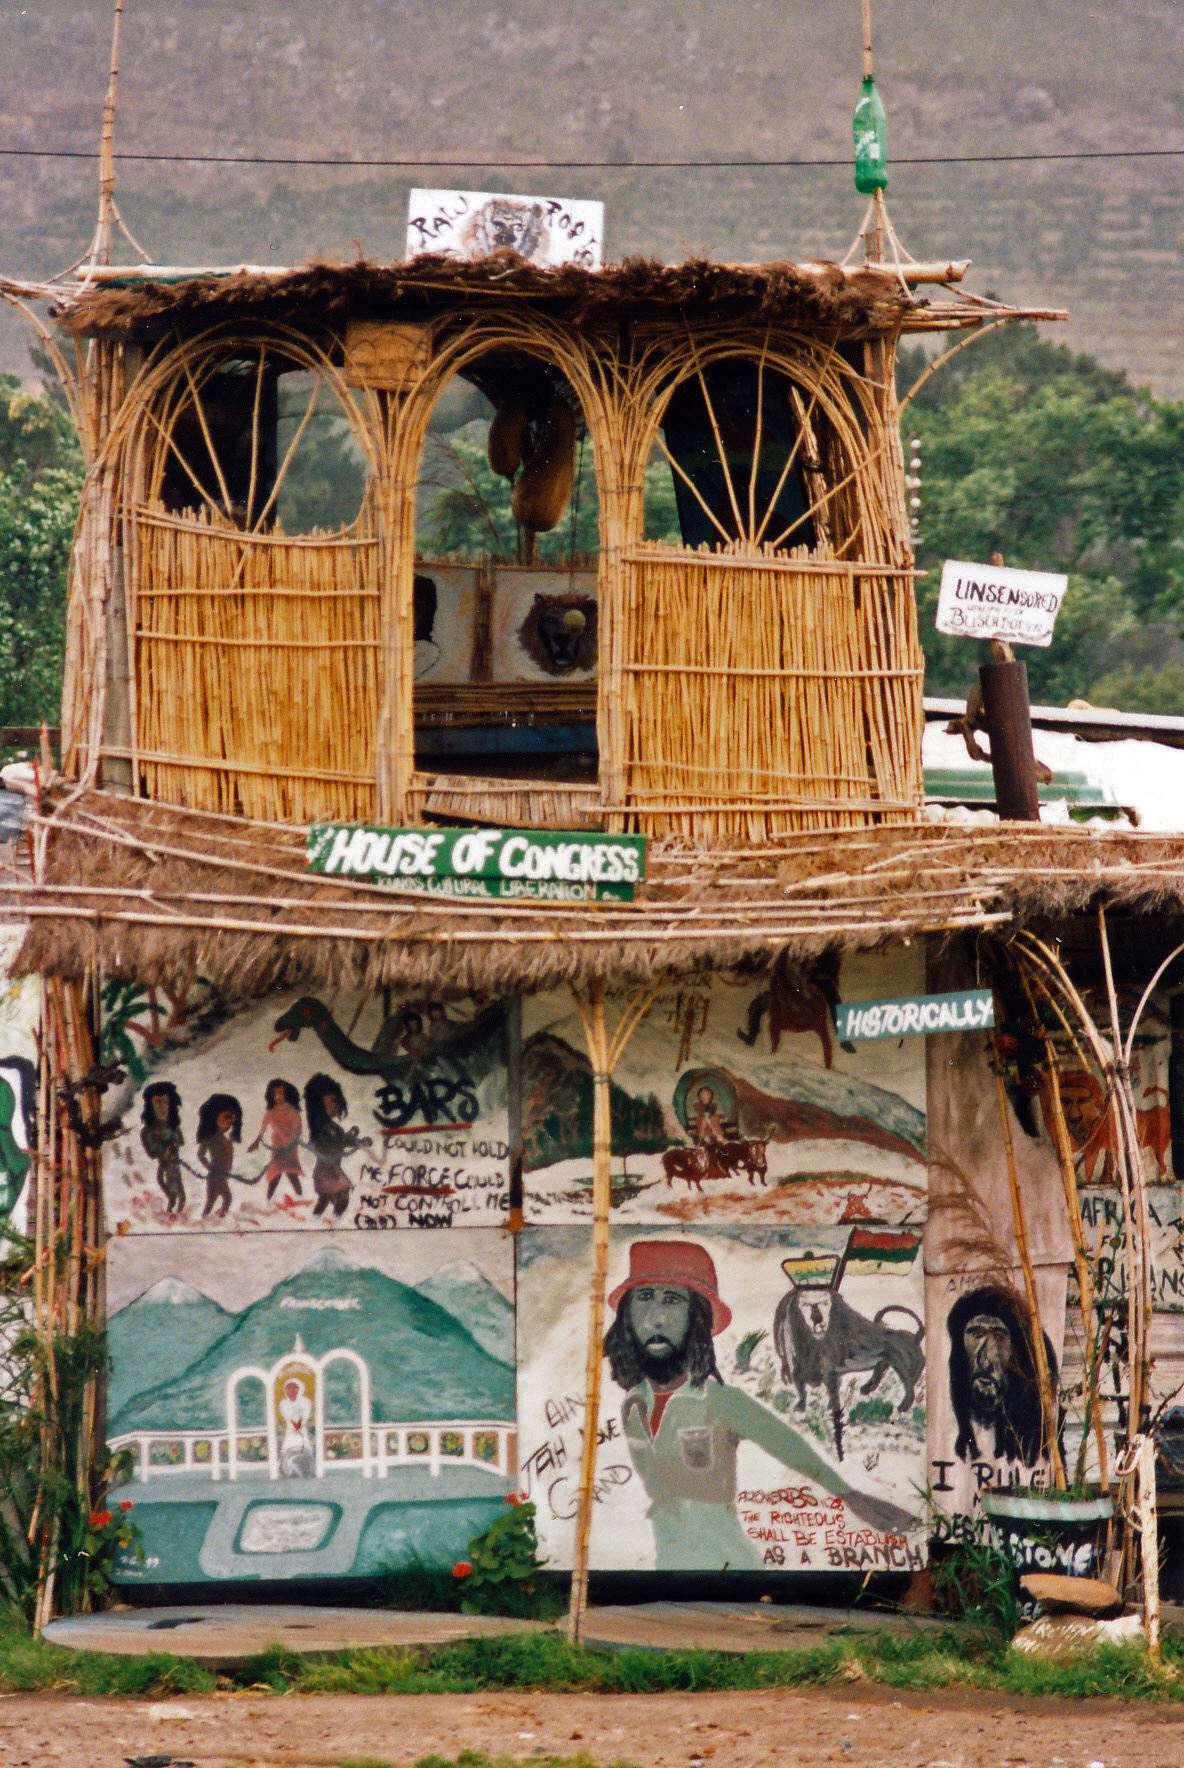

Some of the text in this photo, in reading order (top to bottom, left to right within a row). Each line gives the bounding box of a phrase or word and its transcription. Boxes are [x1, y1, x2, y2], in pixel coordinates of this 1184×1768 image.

[955, 578, 1058, 613] UNSENSORED
[325, 828, 640, 882] HOUSE OF CONGRESS
[846, 997, 994, 1037] HISTORICALLY
[388, 1164, 450, 1186] FORCE
[741, 1511, 845, 1529] THE RIGHTEOUS
[747, 1527, 789, 1543] SHALL
[792, 1530, 817, 1546] BE
[763, 1545, 925, 1571] AS A BRANCH
